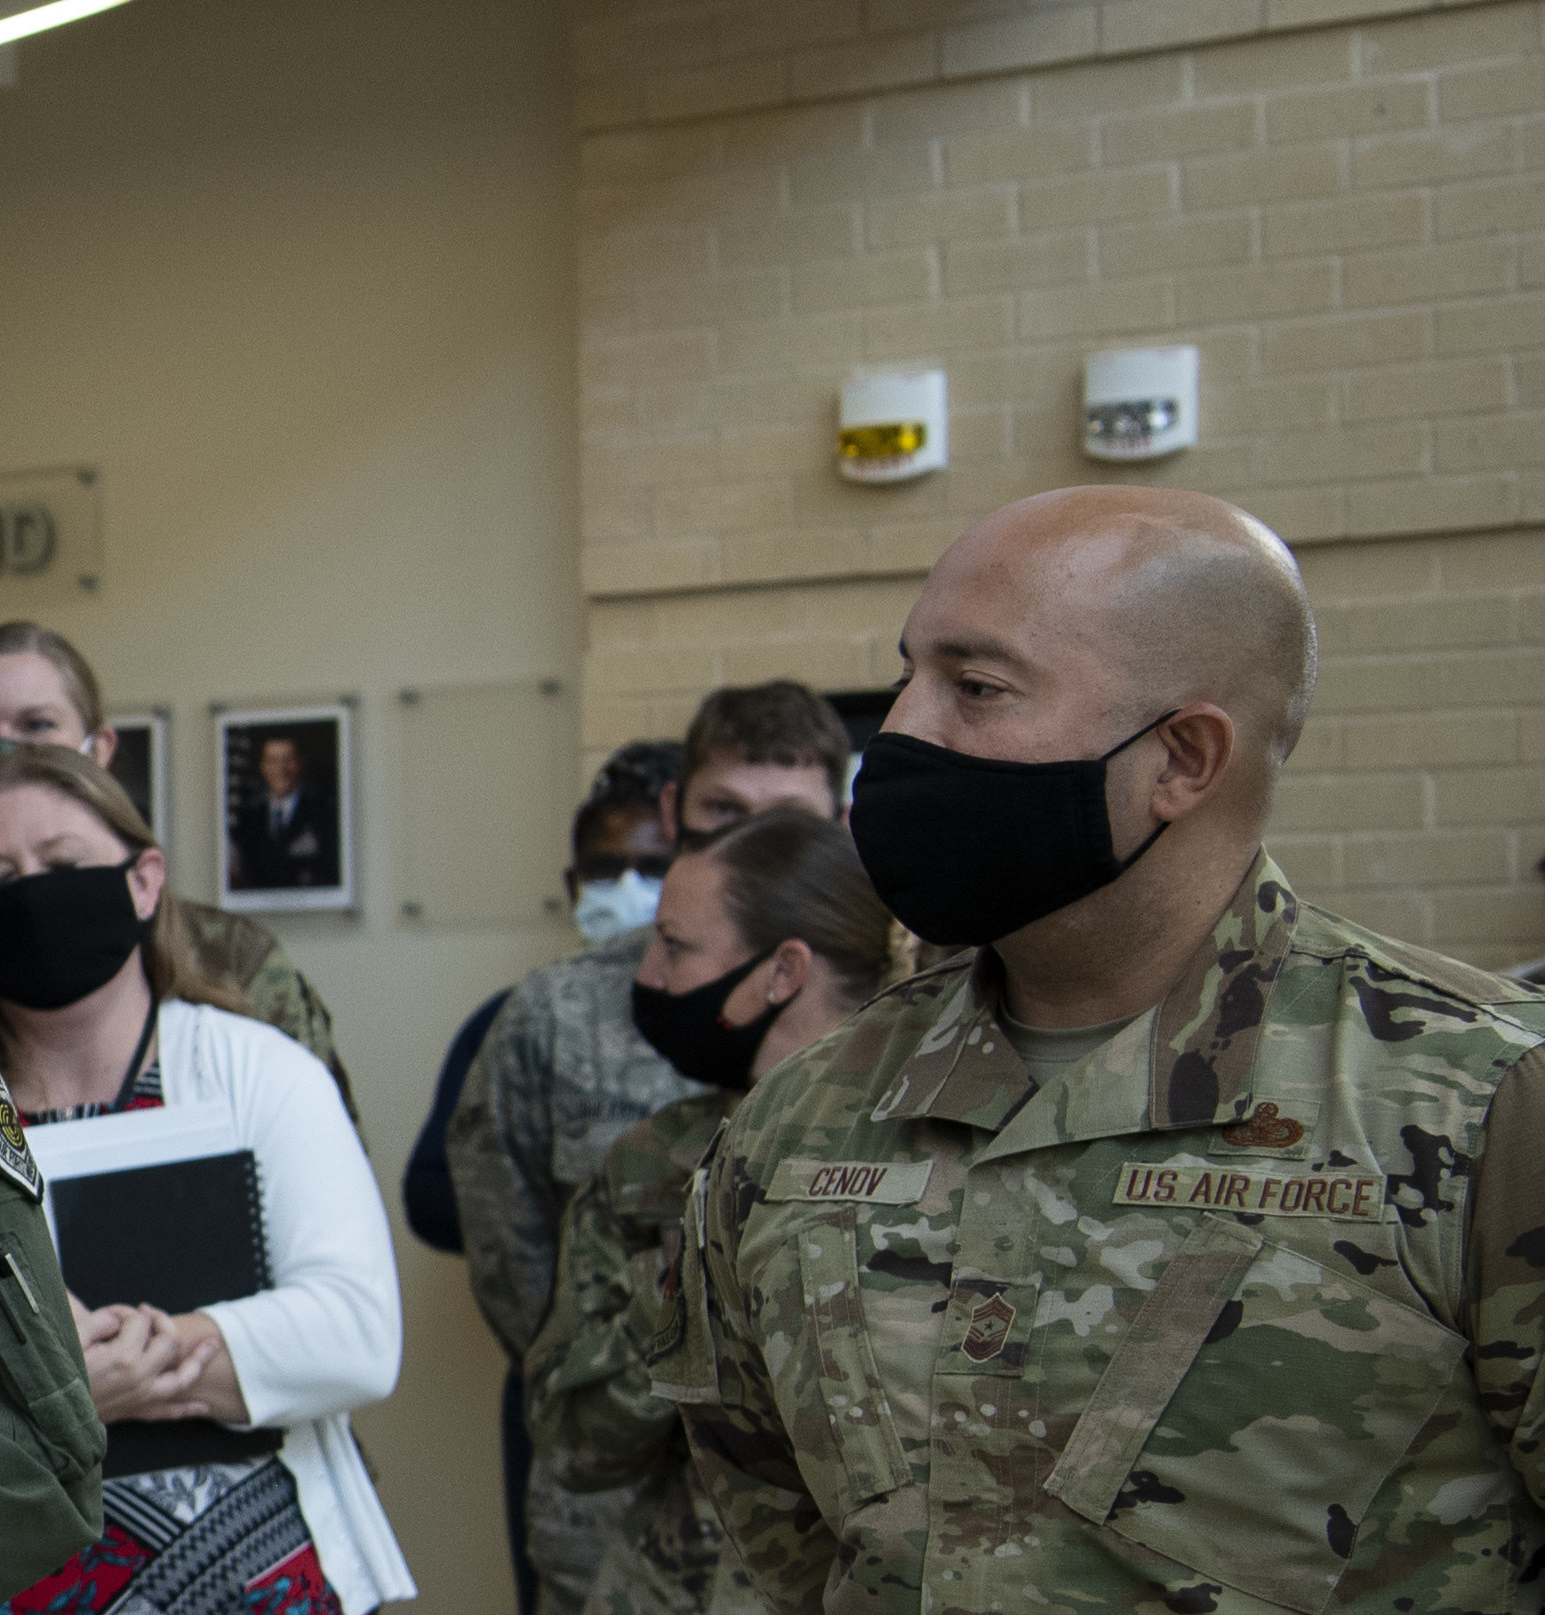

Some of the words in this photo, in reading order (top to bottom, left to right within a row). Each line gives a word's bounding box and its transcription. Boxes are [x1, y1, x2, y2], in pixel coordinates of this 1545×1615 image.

[808, 1166, 888, 1197] CENOV
[1189, 1173, 1251, 1207] AIR
[1259, 1177, 1374, 1216] FORCE
